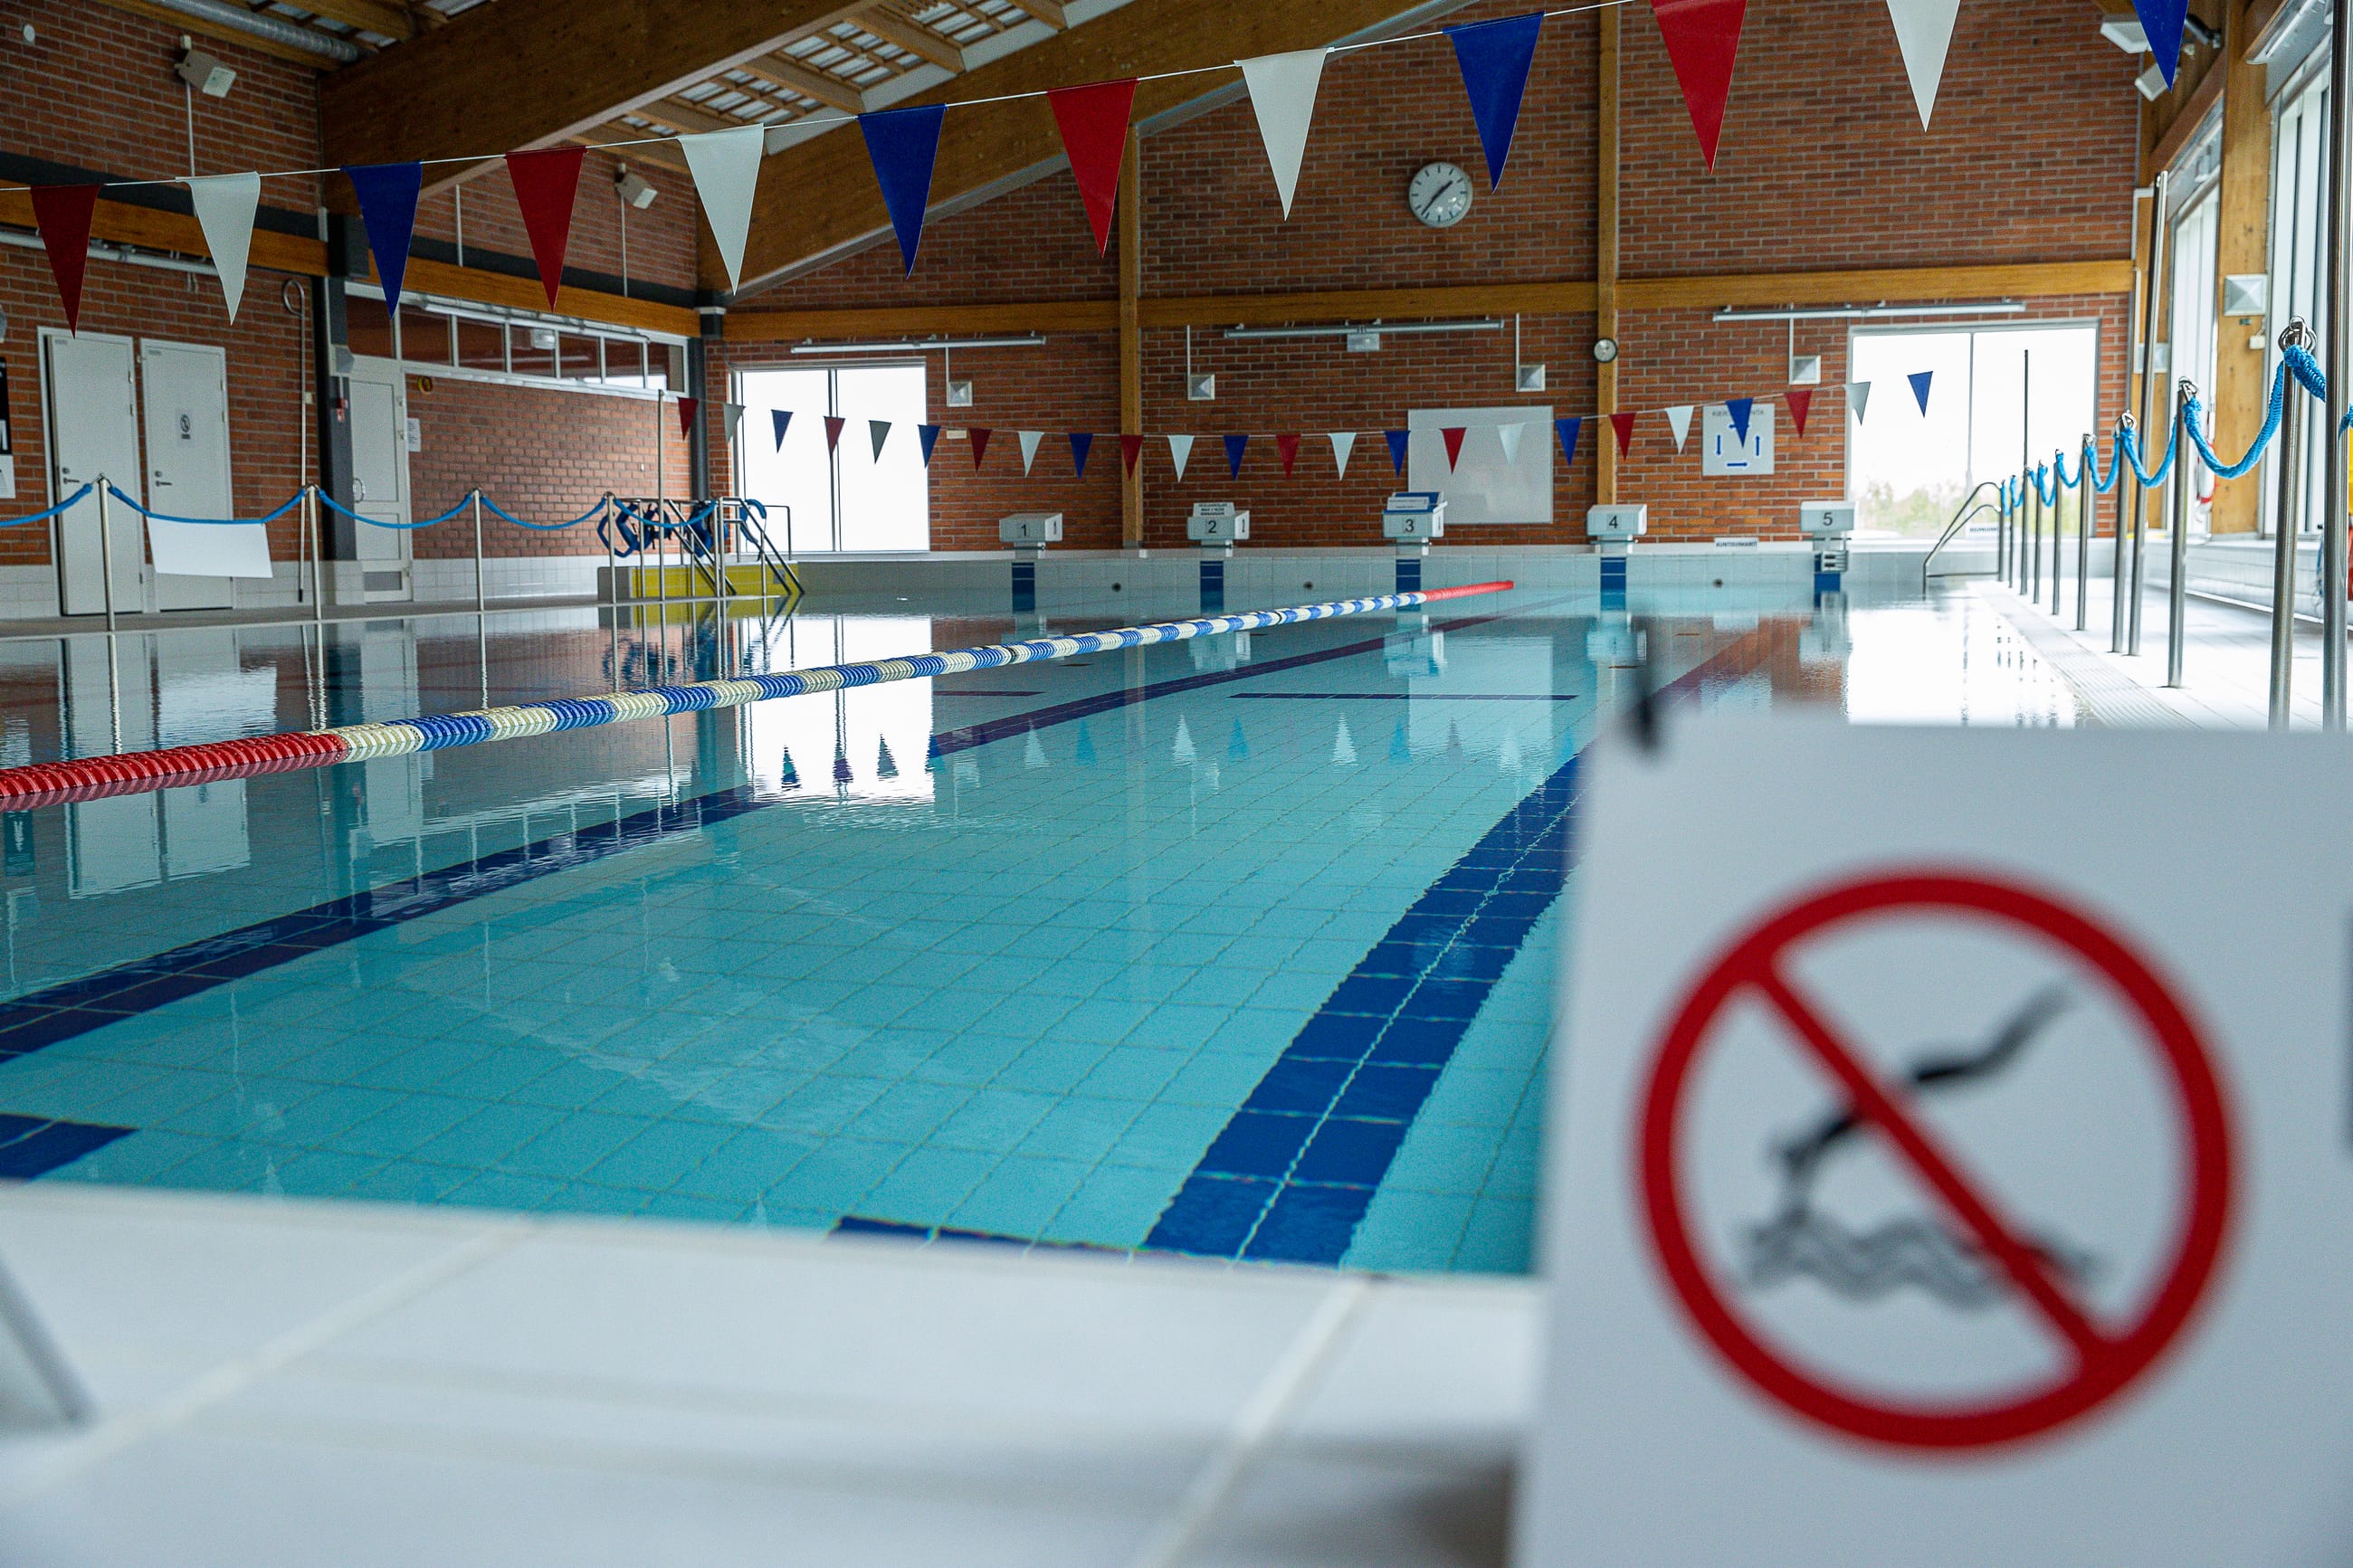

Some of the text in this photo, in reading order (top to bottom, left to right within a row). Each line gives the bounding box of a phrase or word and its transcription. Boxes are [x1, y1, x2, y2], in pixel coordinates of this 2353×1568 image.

[1405, 518, 1415, 532] 3
[1608, 515, 1618, 529] 4
[1823, 512, 1833, 526] 5
[1021, 524, 1026, 536] 1
[1208, 520, 1216, 533] 2
